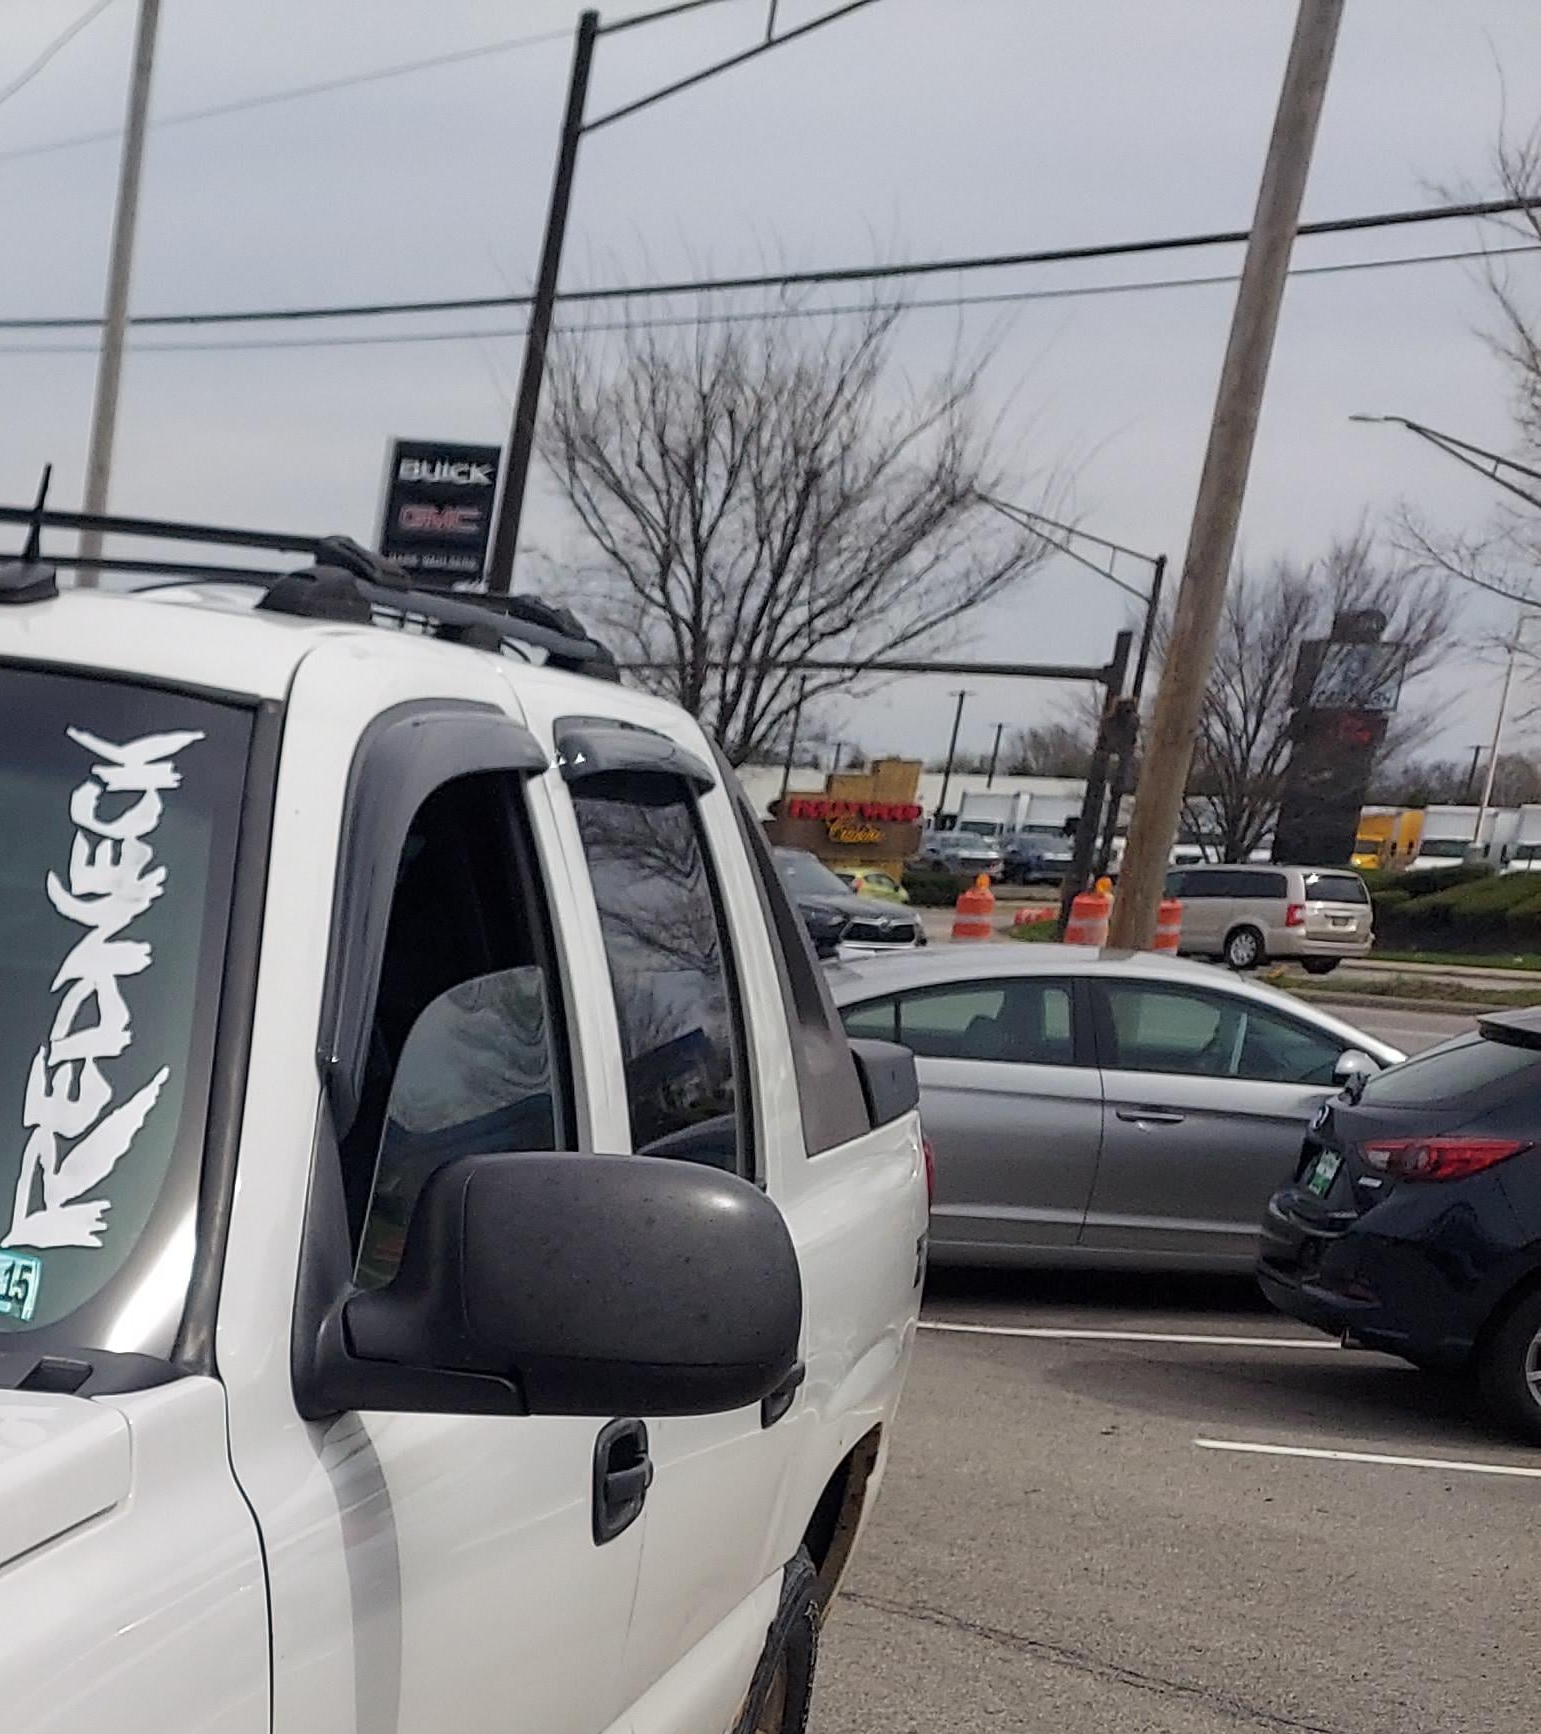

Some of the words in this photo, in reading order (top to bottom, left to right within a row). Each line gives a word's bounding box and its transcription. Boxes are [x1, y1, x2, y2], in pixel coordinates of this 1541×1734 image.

[399, 457, 494, 485] BUICK
[399, 503, 483, 534] GMC
[2, 726, 205, 1249] REDNECK
